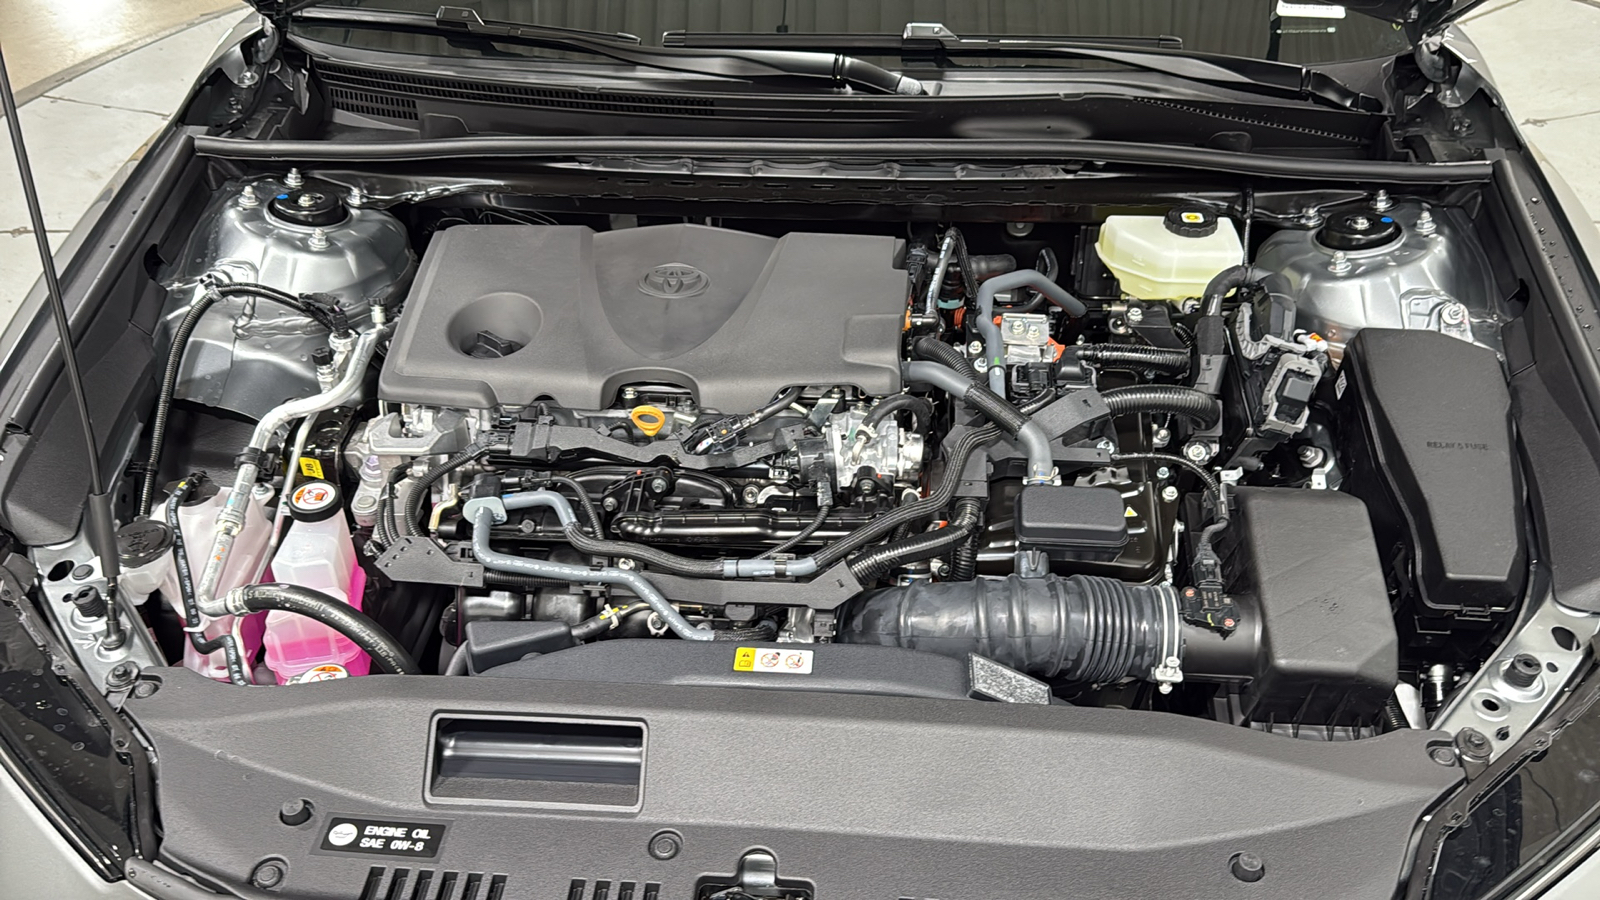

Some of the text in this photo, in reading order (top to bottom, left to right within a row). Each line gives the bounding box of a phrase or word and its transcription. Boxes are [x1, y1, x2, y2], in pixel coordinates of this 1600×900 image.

[1426, 441, 1456, 450] RELAY
[1465, 442, 1490, 450] FUSE
[363, 826, 408, 837] ENGINE
[411, 829, 431, 839] OIL
[359, 838, 425, 851] SAE 0W-8
